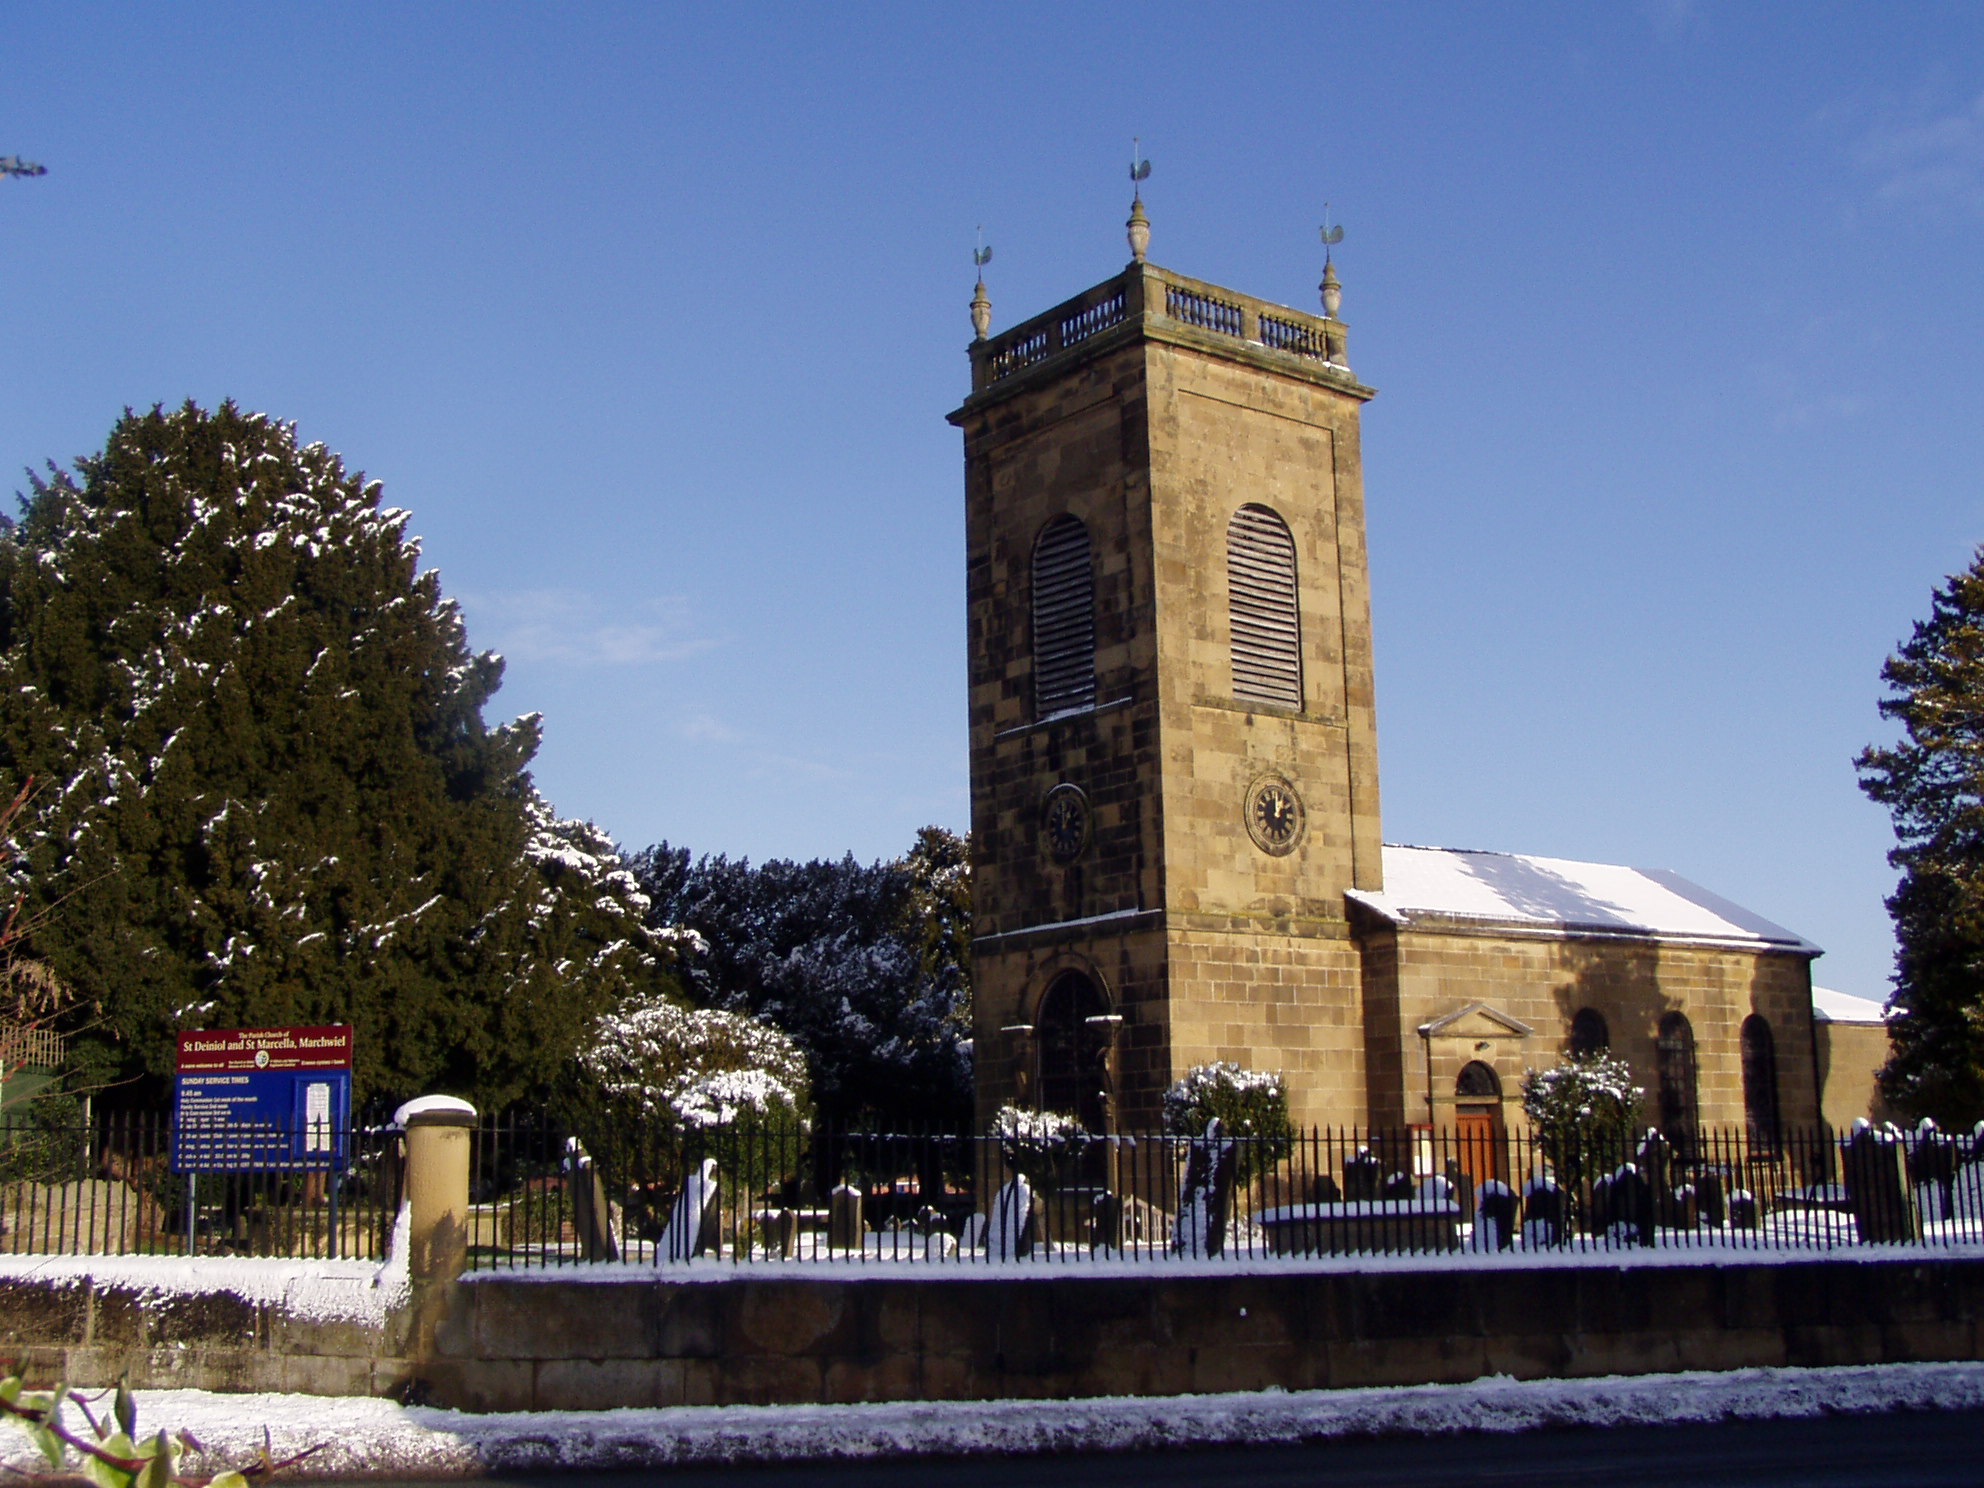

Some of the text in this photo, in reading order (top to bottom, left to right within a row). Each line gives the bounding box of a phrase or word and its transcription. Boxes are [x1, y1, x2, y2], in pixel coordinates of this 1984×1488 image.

[184, 1035, 346, 1052] St Deiniol and St Marcella, Marchwiel
